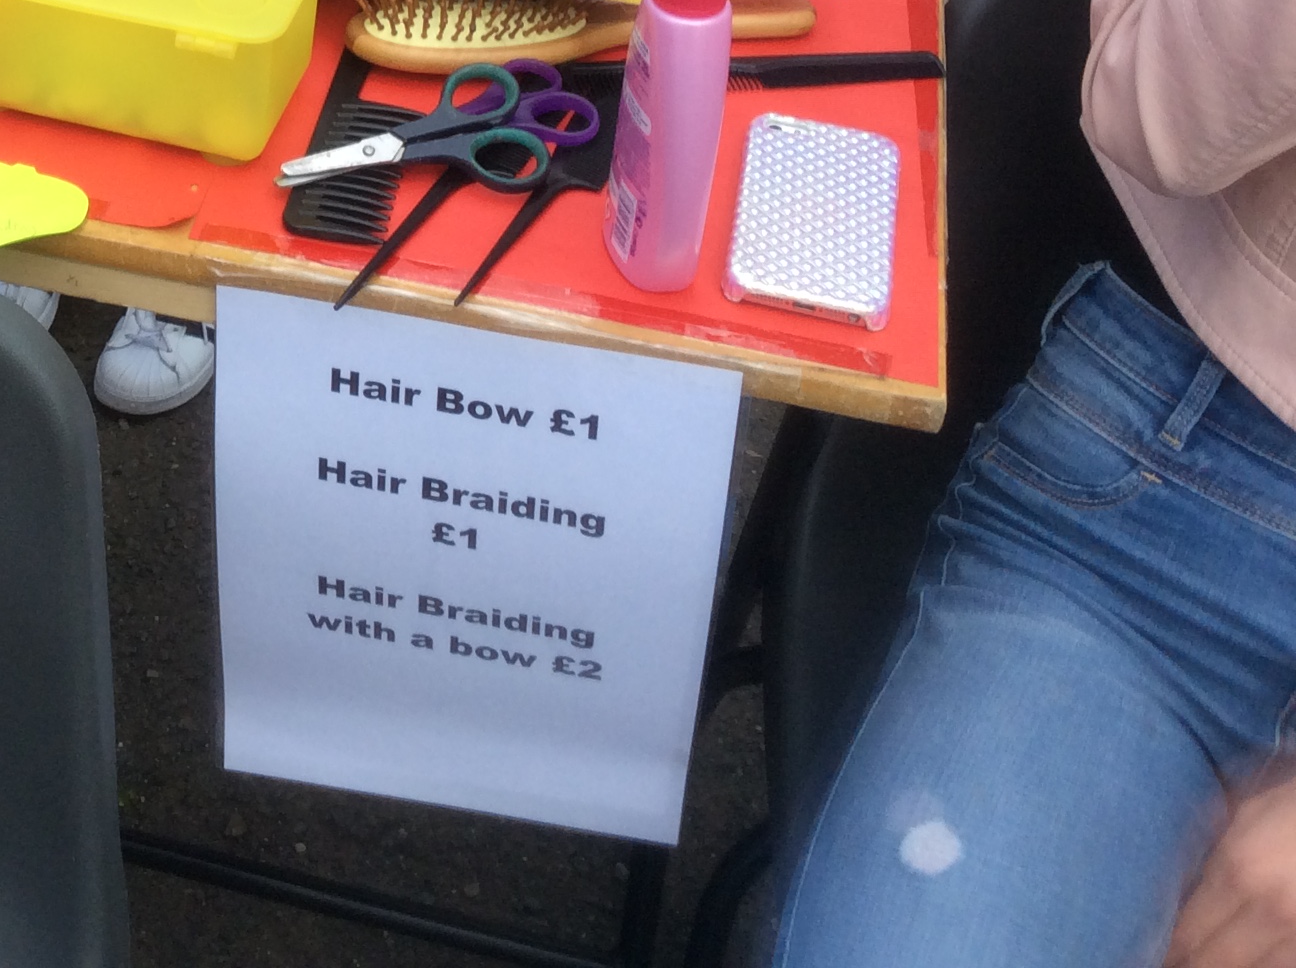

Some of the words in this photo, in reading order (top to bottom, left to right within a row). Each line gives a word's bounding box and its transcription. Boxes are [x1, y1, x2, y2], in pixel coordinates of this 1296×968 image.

[330, 367, 421, 406] Hair
[436, 387, 534, 428] Bow
[550, 409, 599, 440] £1
[318, 457, 407, 495] Hair
[421, 476, 606, 538] Braiding
[432, 522, 477, 550] £1
[307, 612, 396, 643] with
[410, 633, 434, 650] a
[449, 635, 537, 668] bow
[552, 655, 602, 681] £2
[317, 575, 404, 608] Hair
[418, 594, 595, 649] Braiding
